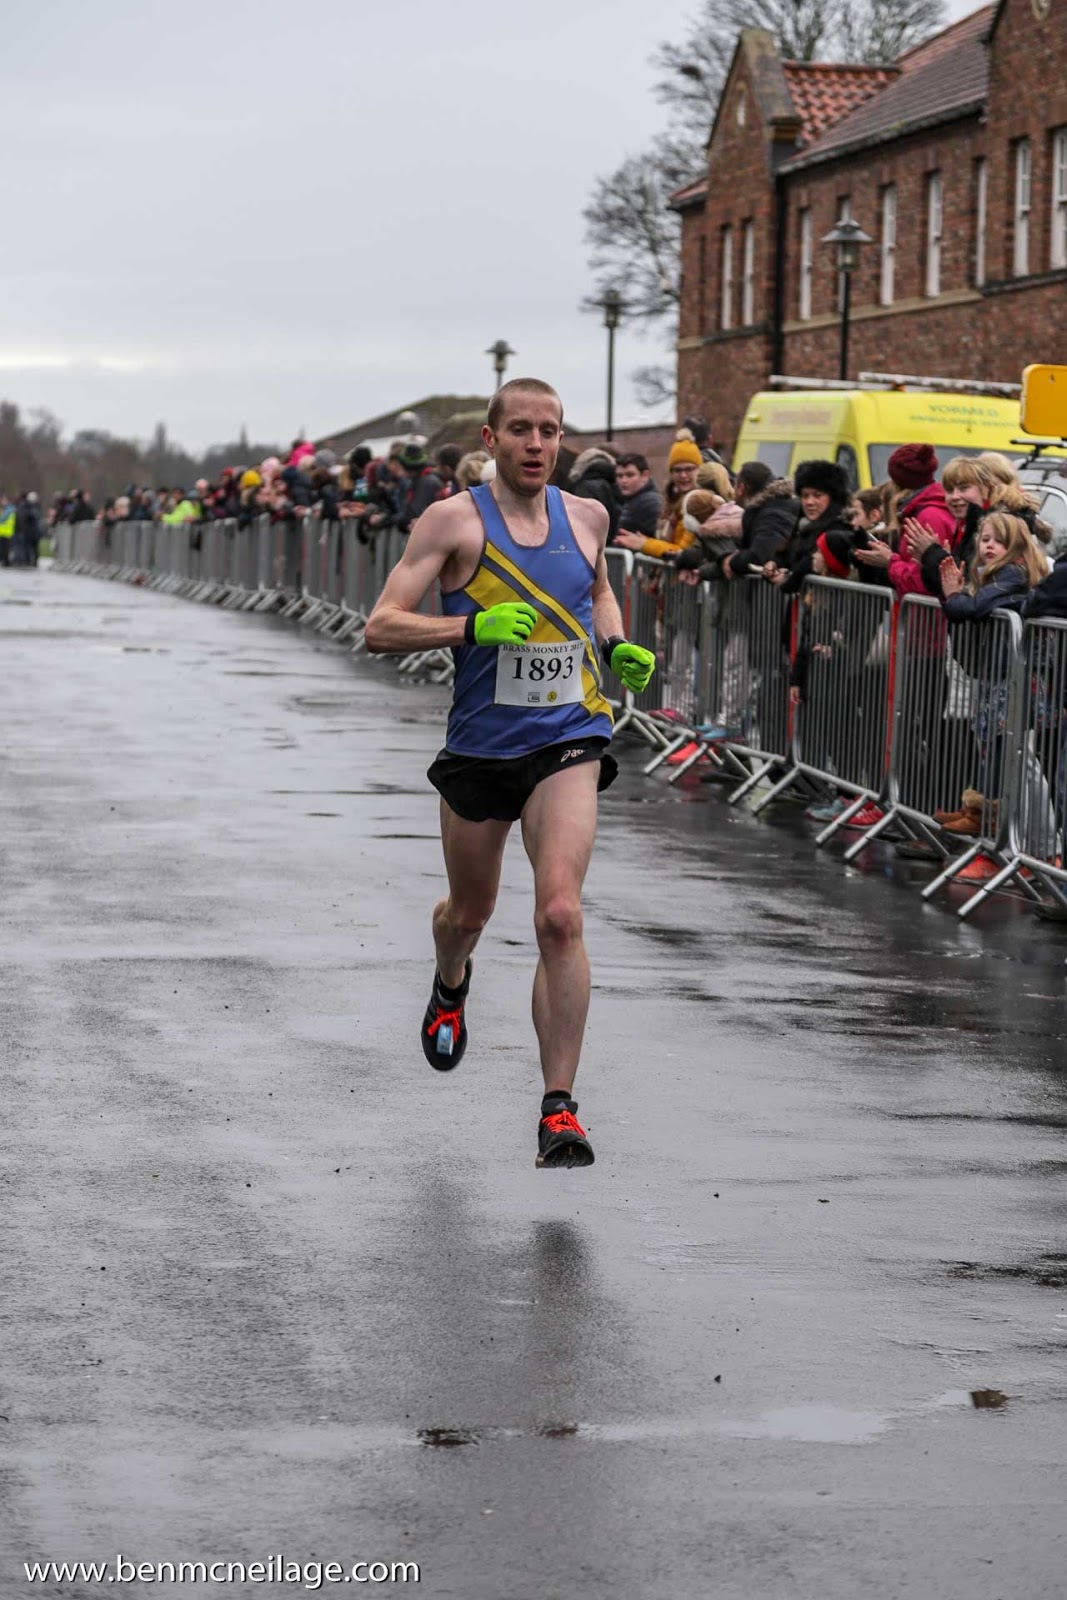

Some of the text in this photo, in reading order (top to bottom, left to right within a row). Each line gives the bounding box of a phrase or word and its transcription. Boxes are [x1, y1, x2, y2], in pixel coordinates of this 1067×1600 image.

[503, 642, 584, 654] BRASS MONKEY 2017
[512, 656, 574, 682] 1893
